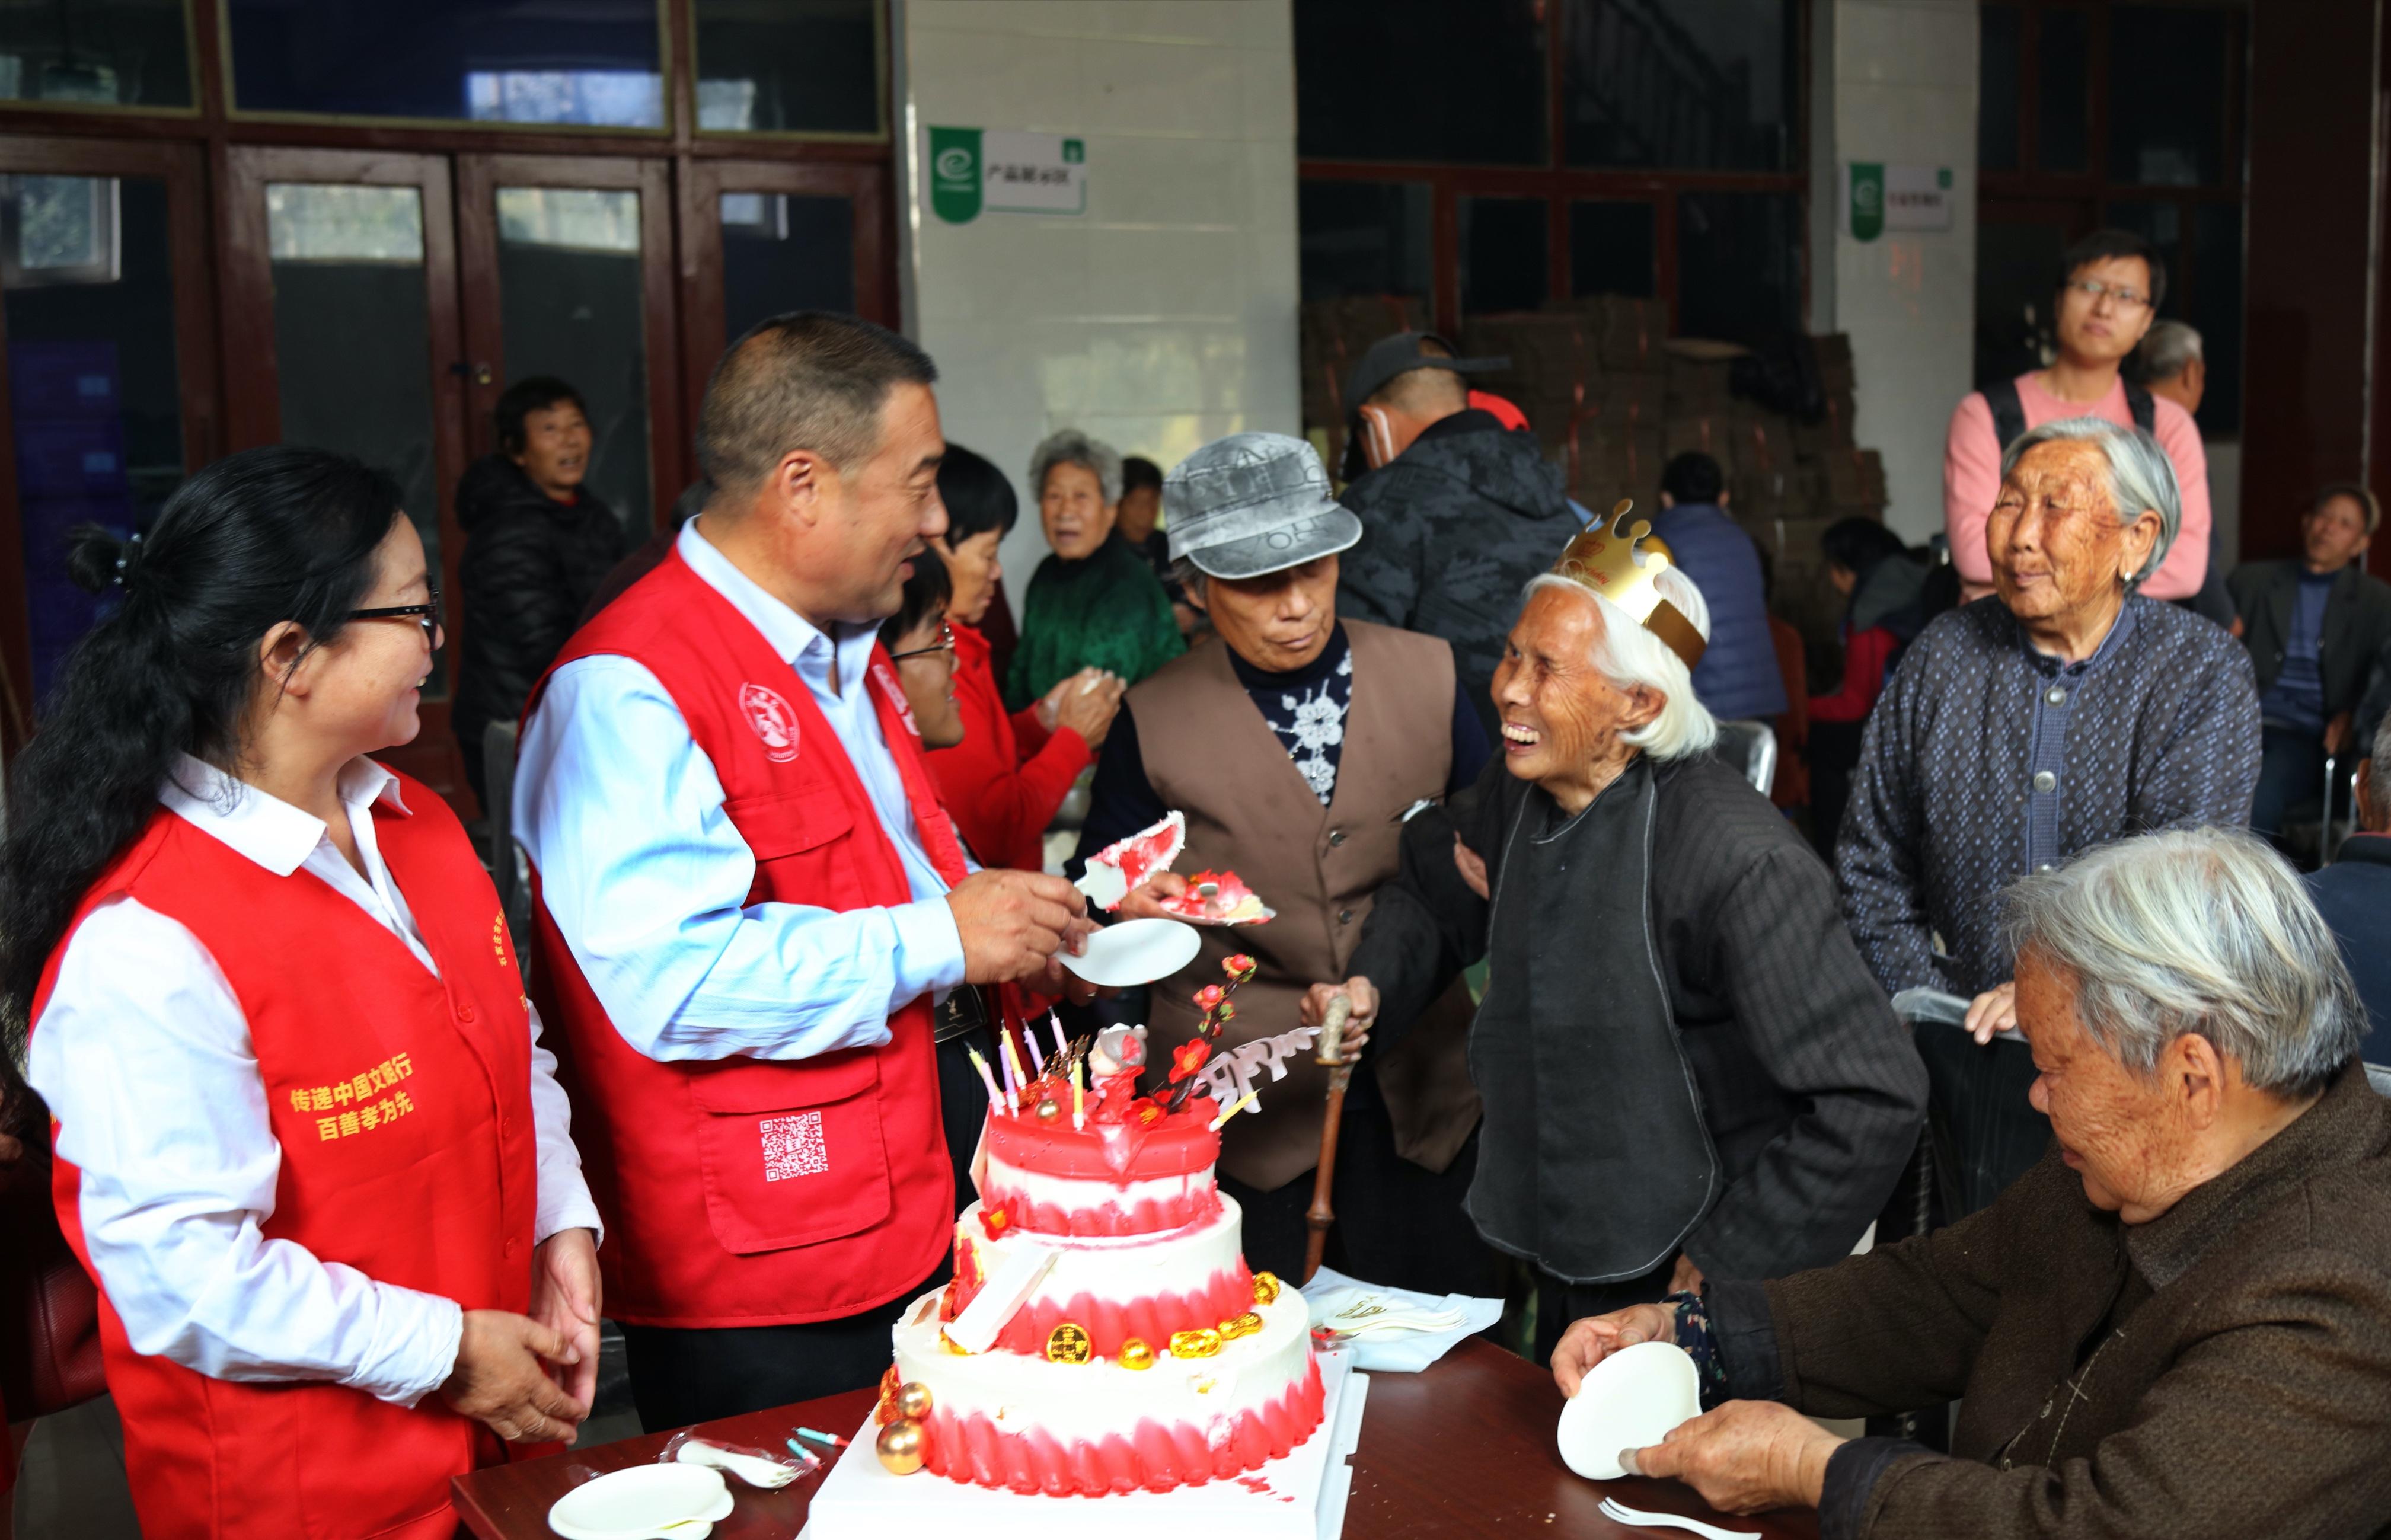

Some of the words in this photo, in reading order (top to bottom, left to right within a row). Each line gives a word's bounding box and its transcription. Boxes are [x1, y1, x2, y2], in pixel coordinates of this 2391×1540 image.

[290, 1052, 413, 1113] 传递中国文明行
[315, 1090, 414, 1141] 百善孝为先
